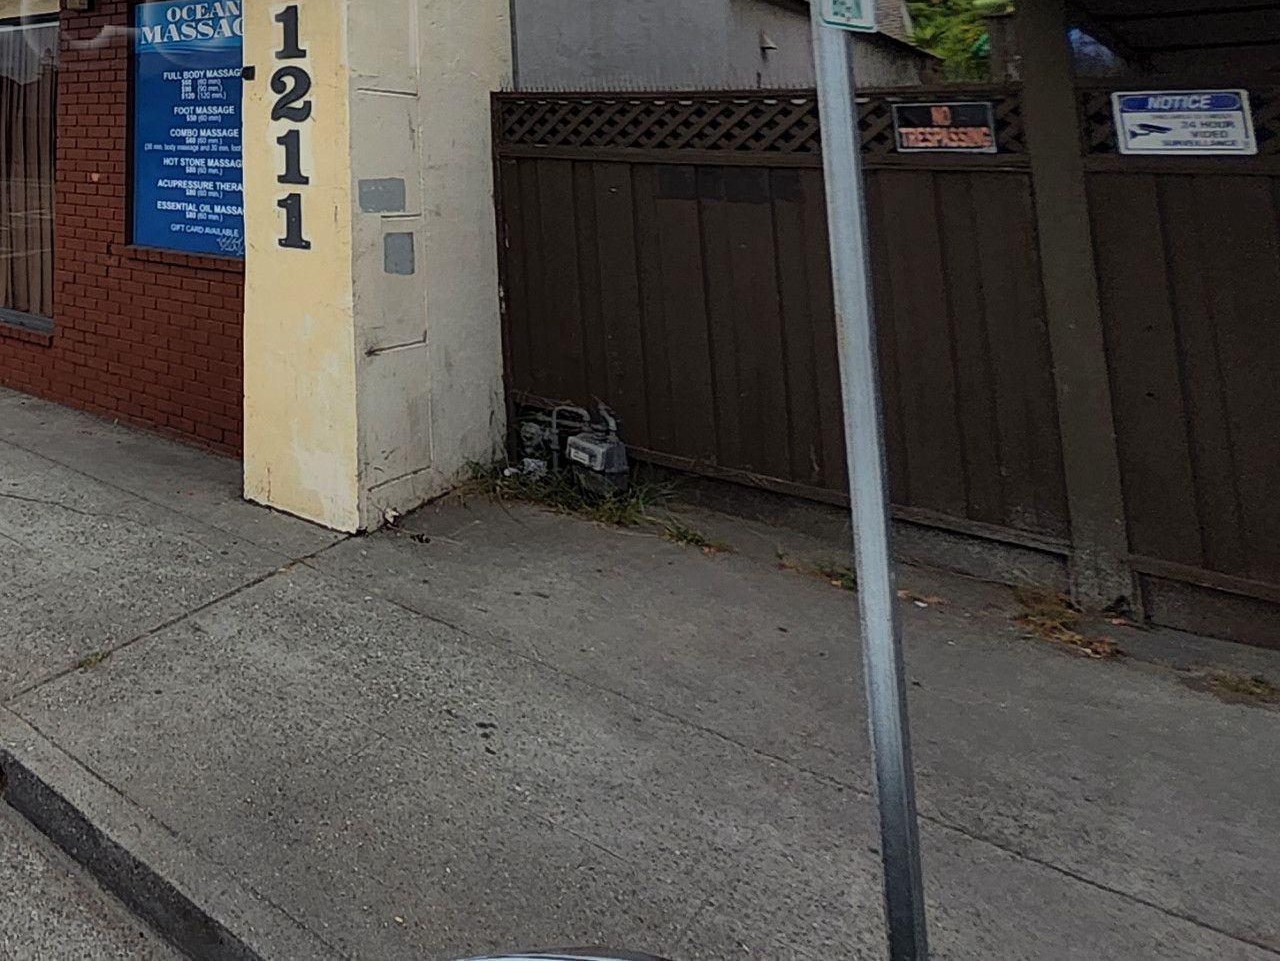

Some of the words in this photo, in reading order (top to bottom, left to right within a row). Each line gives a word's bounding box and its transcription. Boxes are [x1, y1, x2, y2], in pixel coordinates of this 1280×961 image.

[166, 0, 240, 22] OCEAN
[141, 18, 243, 44] MASSA
[163, 72, 182, 80] FULL
[183, 70, 205, 79] BODY
[206, 69, 242, 78] MASSAG
[1147, 95, 1211, 110] NOTICE
[174, 107, 194, 115] FOOT
[195, 106, 235, 115] MASSAGE
[169, 128, 198, 137] COMBO
[200, 129, 239, 137] MASSAGE
[271, 5, 312, 250] 1211
[163, 157, 178, 166] HOT
[180, 157, 205, 167] STONE
[207, 159, 243, 168] MASSAG
[157, 179, 214, 190] ACUPRESSURE
[215, 182, 243, 191] THERA
[157, 201, 198, 212] ESSENTIAL
[199, 204, 213, 213] OIL
[214, 205, 244, 215] MASSA
[170, 223, 185, 232] GIFT
[186, 224, 204, 234] CARD
[204, 226, 240, 237] AVAILABLE
